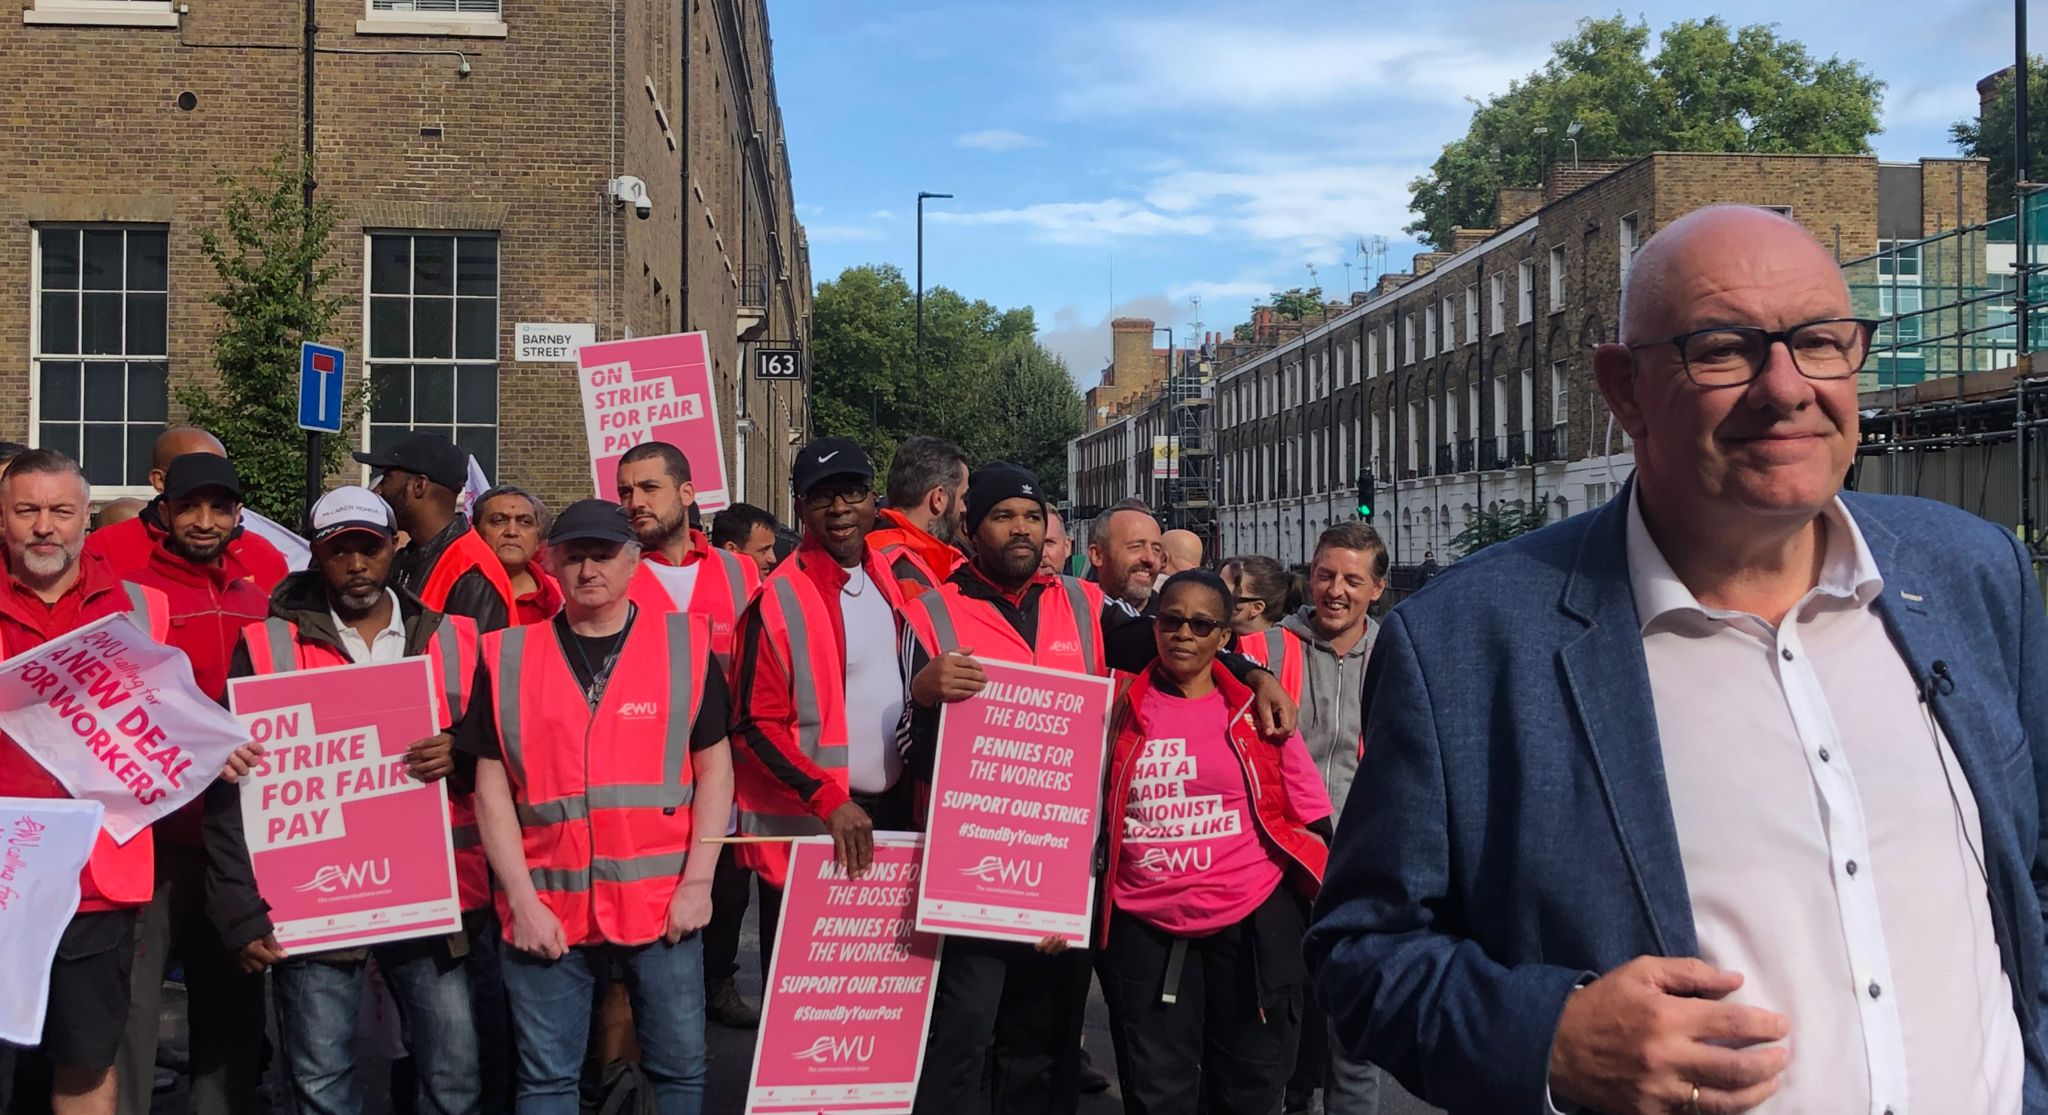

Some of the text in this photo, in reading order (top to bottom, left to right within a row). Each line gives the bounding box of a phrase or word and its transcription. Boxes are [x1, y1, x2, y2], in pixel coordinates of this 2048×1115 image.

[522, 335, 572, 344] BARNBY
[522, 347, 567, 357] STREET
[591, 367, 622, 387] ON
[762, 355, 794, 374] 163
[595, 382, 665, 409] STRIKE
[600, 400, 693, 431] FOR FAIR
[604, 430, 644, 452] PAY
[80, 630, 161, 706] CWU calling for
[616, 702, 657, 716] CWU
[974, 681, 1084, 714] MILLIONS FOR
[47, 647, 192, 789] A NEW DEAL
[250, 712, 299, 743] ON
[984, 705, 1071, 735] THE BOSSES
[14, 660, 167, 806] FOR WORKERS
[255, 734, 365, 777] STRIKE
[972, 735, 1074, 768] PENNIES FOR
[1161, 743, 1179, 757] IS
[969, 760, 1073, 792] THE WORKERS
[1133, 761, 1190, 780] HAT A
[262, 761, 409, 811] FOR FAIR
[1130, 782, 1178, 802] RADE
[942, 790, 1090, 825] SUPPORT OUR STRIKE
[267, 808, 330, 843] PAY
[959, 822, 1069, 849] #StandByYourPost
[1191, 815, 1234, 836] LIKE
[817, 860, 921, 882] MILONS FO
[958, 855, 1043, 887] CWU
[1132, 846, 1211, 872] CWU
[292, 857, 391, 892] CWU
[827, 886, 913, 906] THE BOSSES
[812, 917, 915, 938] PENNIES FOR
[808, 942, 912, 962] THE WORKERS
[779, 975, 926, 993] SUPPORT OUR STRIKE
[794, 1005, 903, 1024] #StandByYourPost
[791, 1035, 875, 1063] CWU
